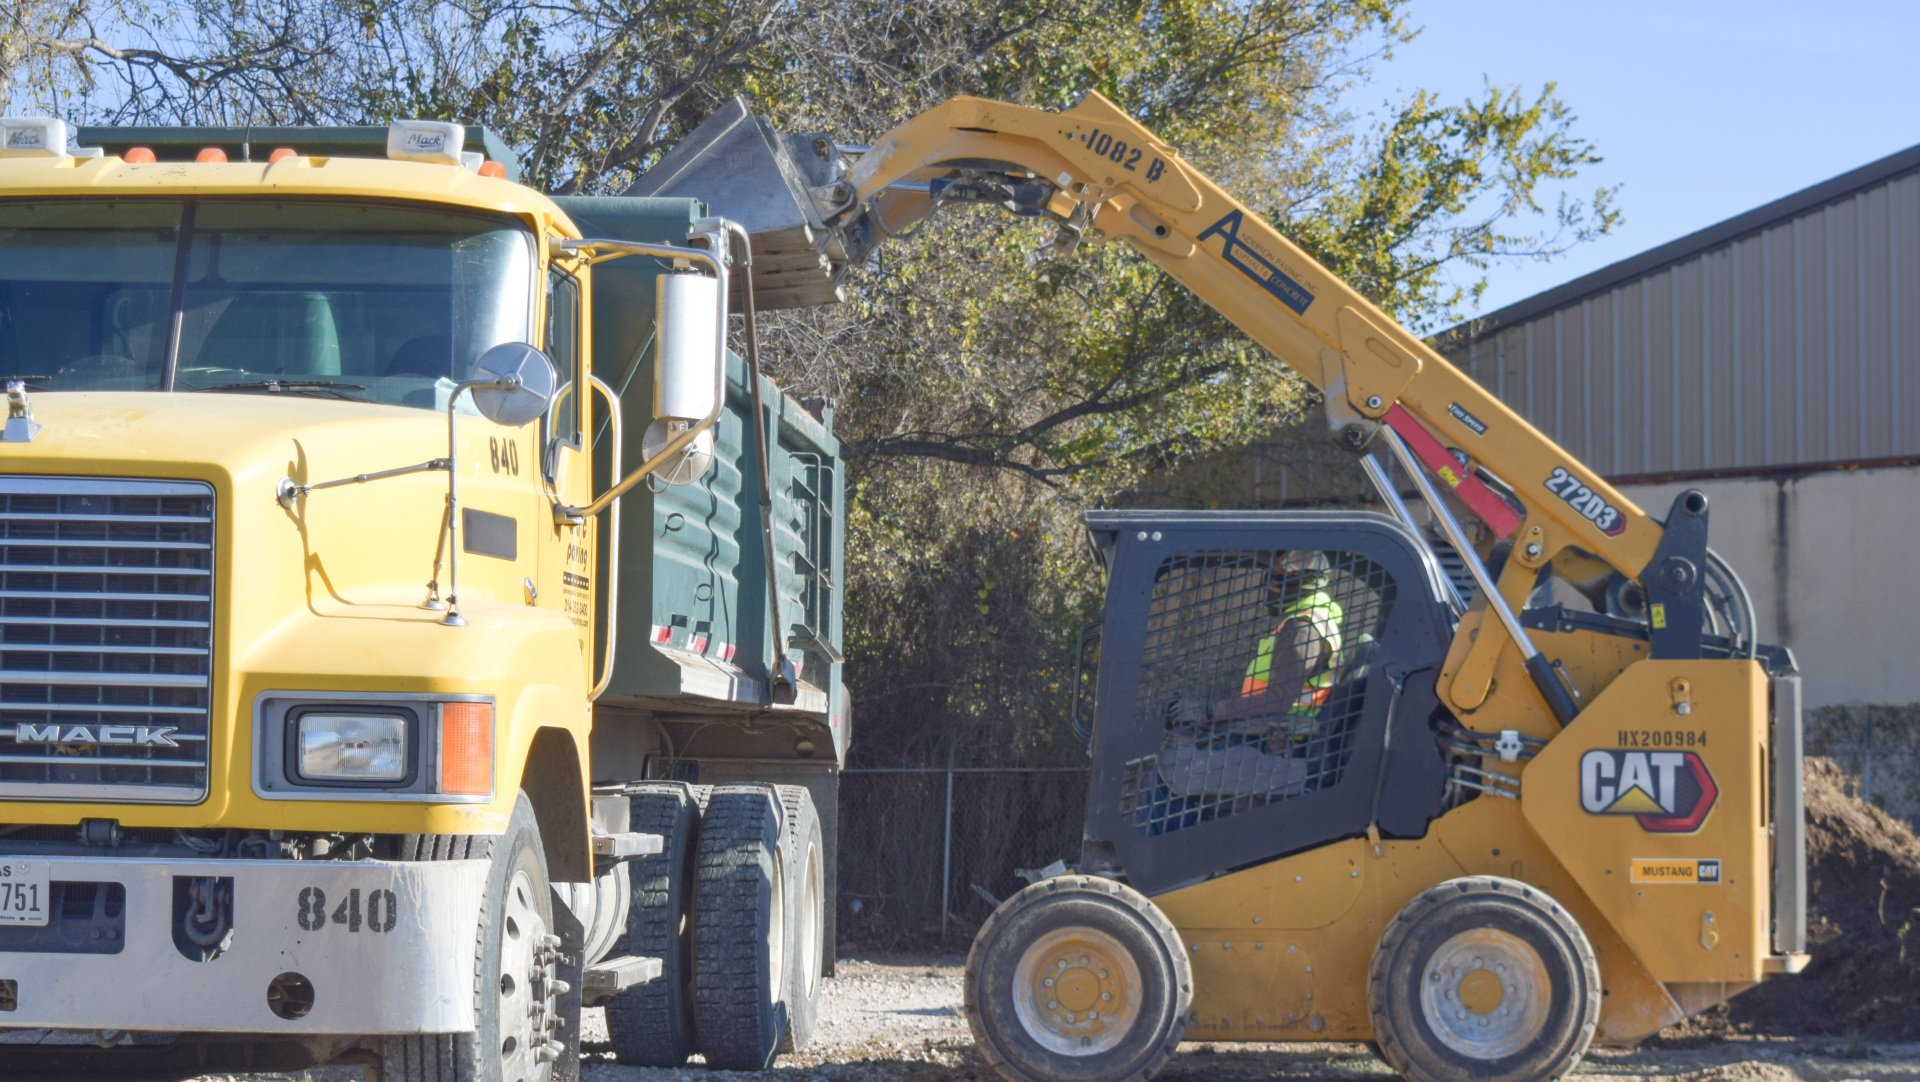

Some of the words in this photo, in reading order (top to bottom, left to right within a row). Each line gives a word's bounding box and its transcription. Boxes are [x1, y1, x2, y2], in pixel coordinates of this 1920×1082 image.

[407, 133, 441, 145] Mack
[1086, 128, 1142, 172] 1082
[1145, 157, 1165, 182] B
[1269, 275, 1310, 307] CONCRETE
[489, 435, 519, 477] 840
[1544, 467, 1618, 530] 272D3
[16, 723, 179, 748] MACK
[1617, 730, 1707, 747] HX200984
[1581, 750, 1684, 814] CAT
[1642, 865, 1693, 877] MUSTANG
[1698, 865, 1718, 878] CAT
[298, 886, 397, 933] 840
